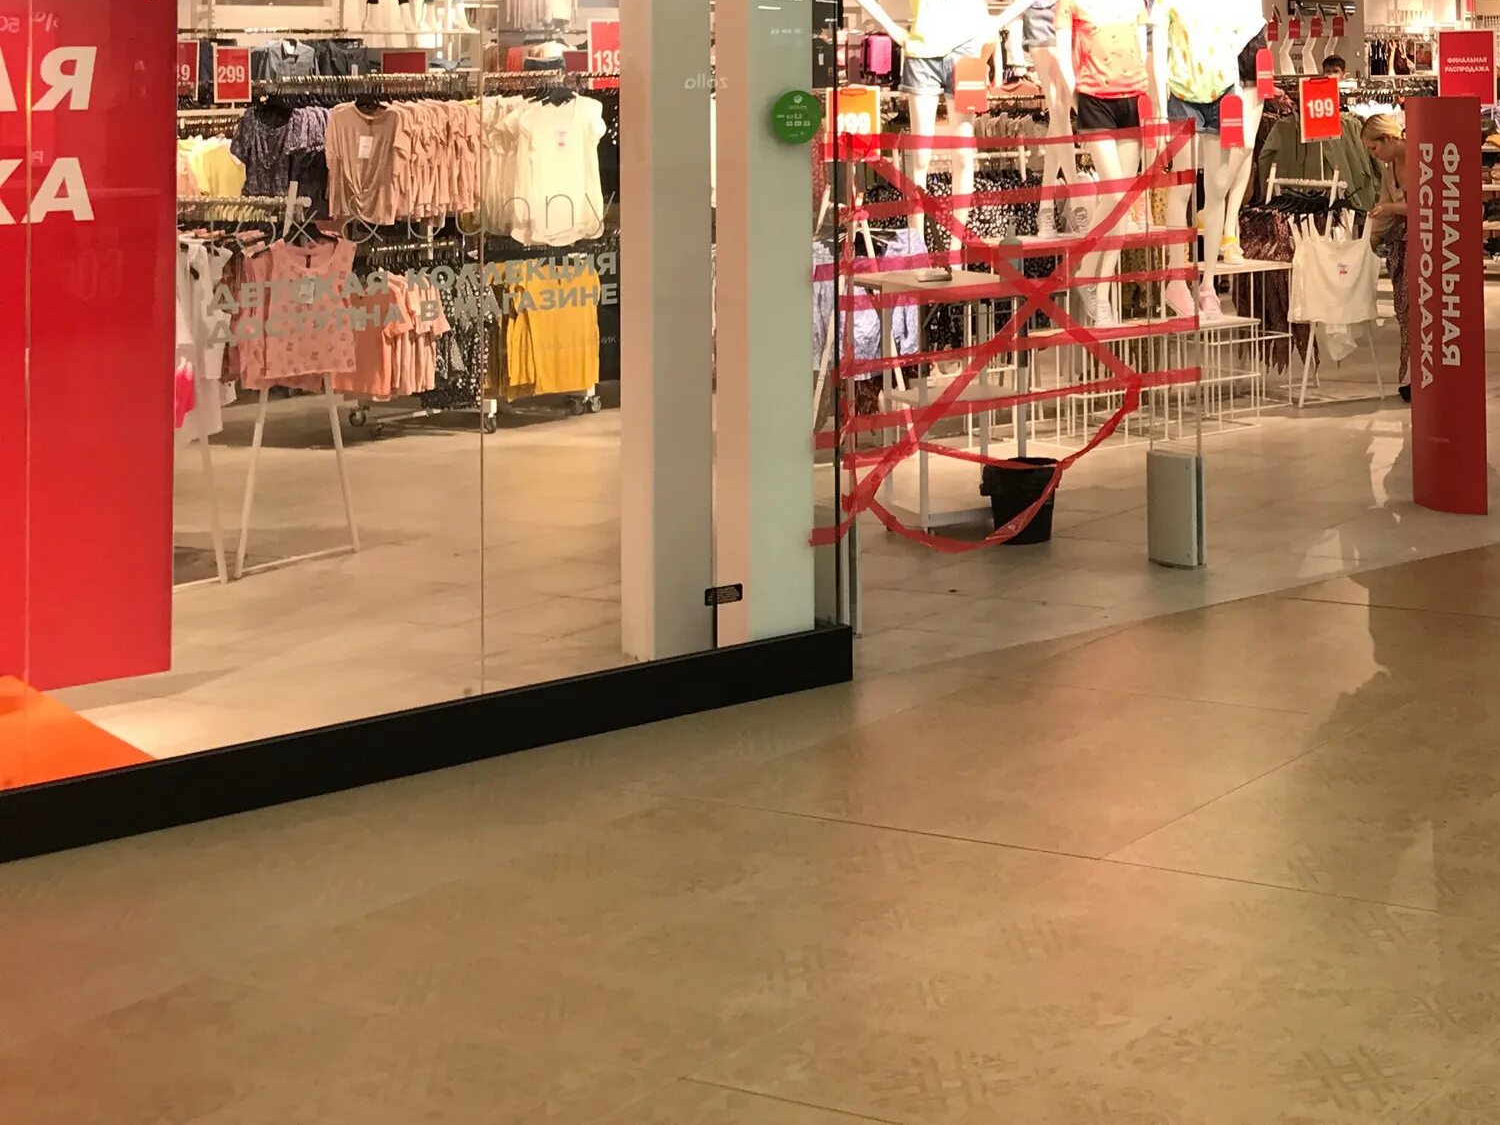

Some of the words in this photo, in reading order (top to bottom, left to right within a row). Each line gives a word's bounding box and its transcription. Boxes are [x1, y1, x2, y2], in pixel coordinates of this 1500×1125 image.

[218, 65, 245, 83] 299
[1307, 98, 1334, 119] 199
[406, 251, 618, 291] КОЛЛЕКЦИЯ
[1419, 143, 1434, 389] РАСПРОДАЖА
[1442, 142, 1461, 367] ФИНАЛЬНАЯ
[420, 299, 439, 322] В
[454, 283, 618, 318] МАГАЗИНЕ
